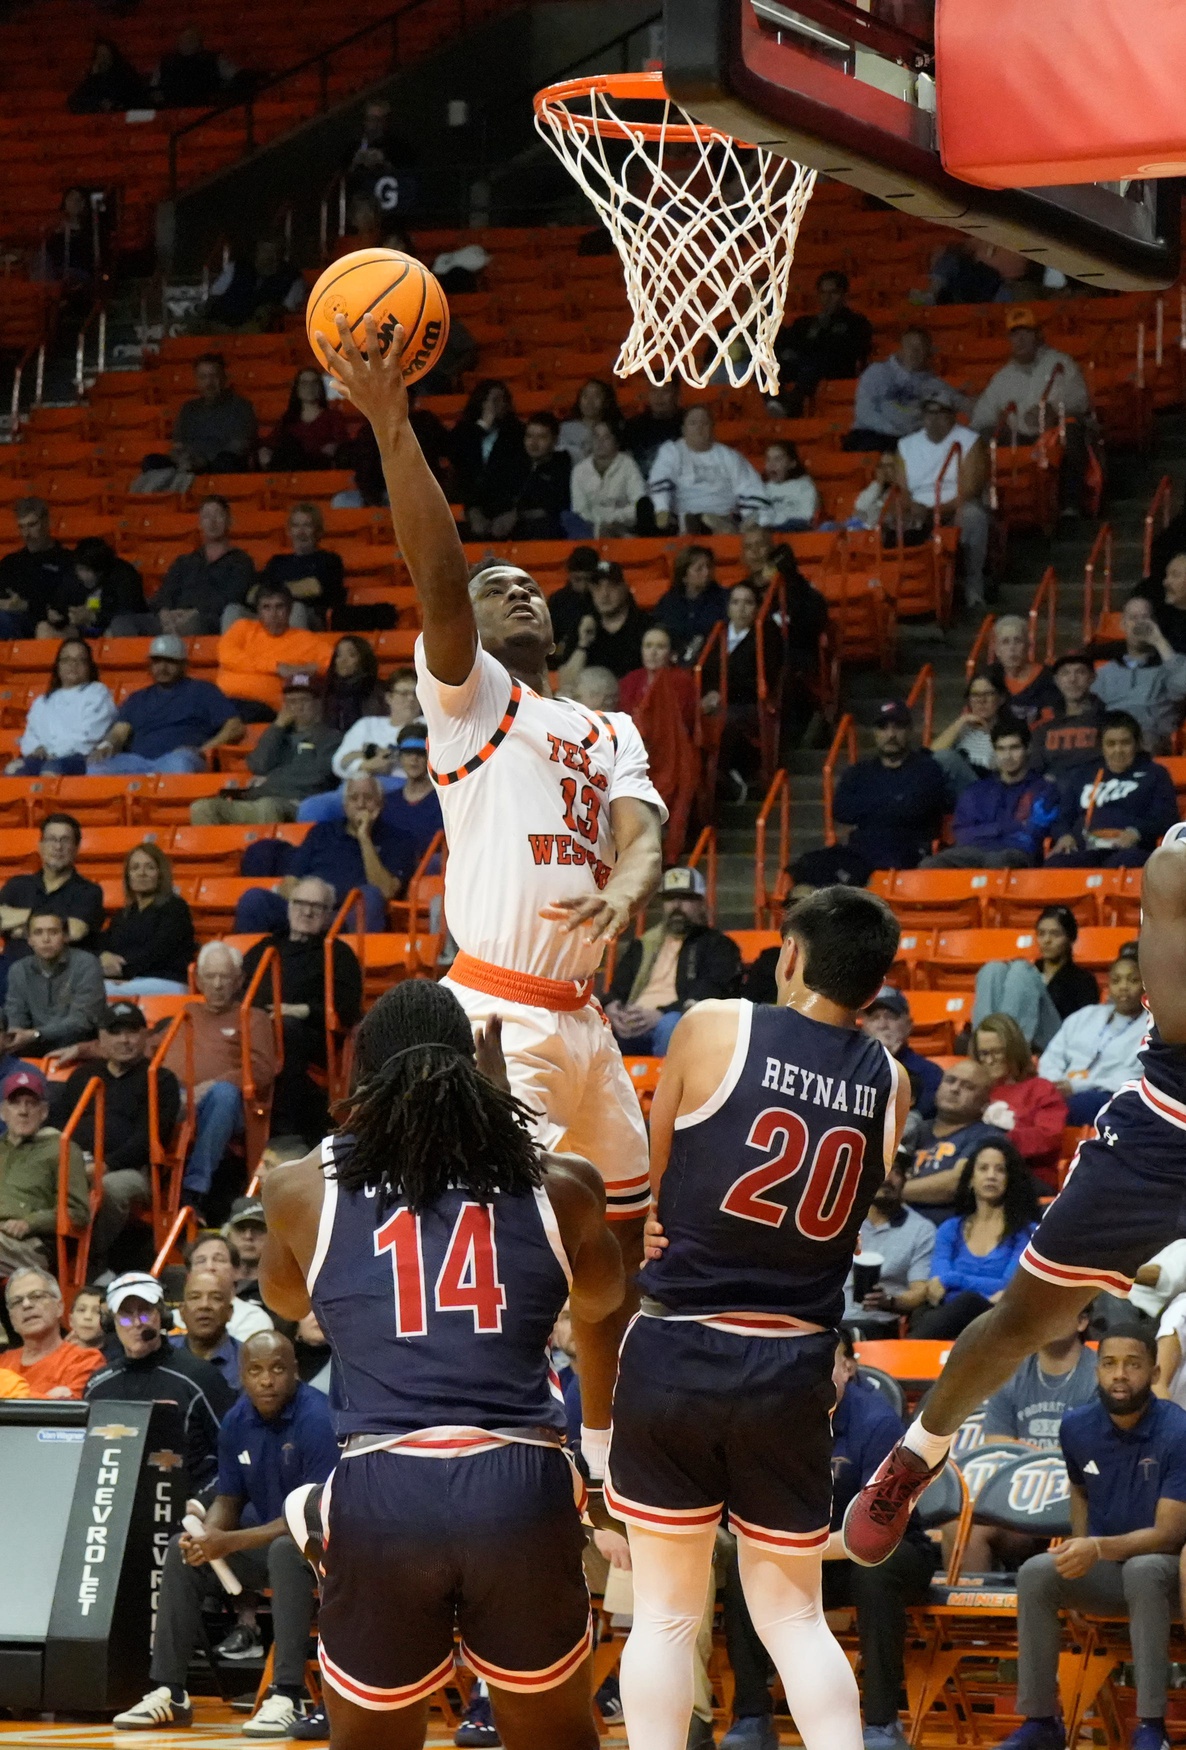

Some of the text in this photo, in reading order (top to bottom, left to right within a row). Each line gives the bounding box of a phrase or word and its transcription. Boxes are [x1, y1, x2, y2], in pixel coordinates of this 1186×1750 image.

[560, 776, 601, 845] 13
[761, 1056, 878, 1119] REYNA III
[719, 1106, 867, 1242] 20
[373, 1201, 508, 1338] 14
[78, 1449, 122, 1617] CHEVROLET
[946, 1592, 1019, 1608] MINER
